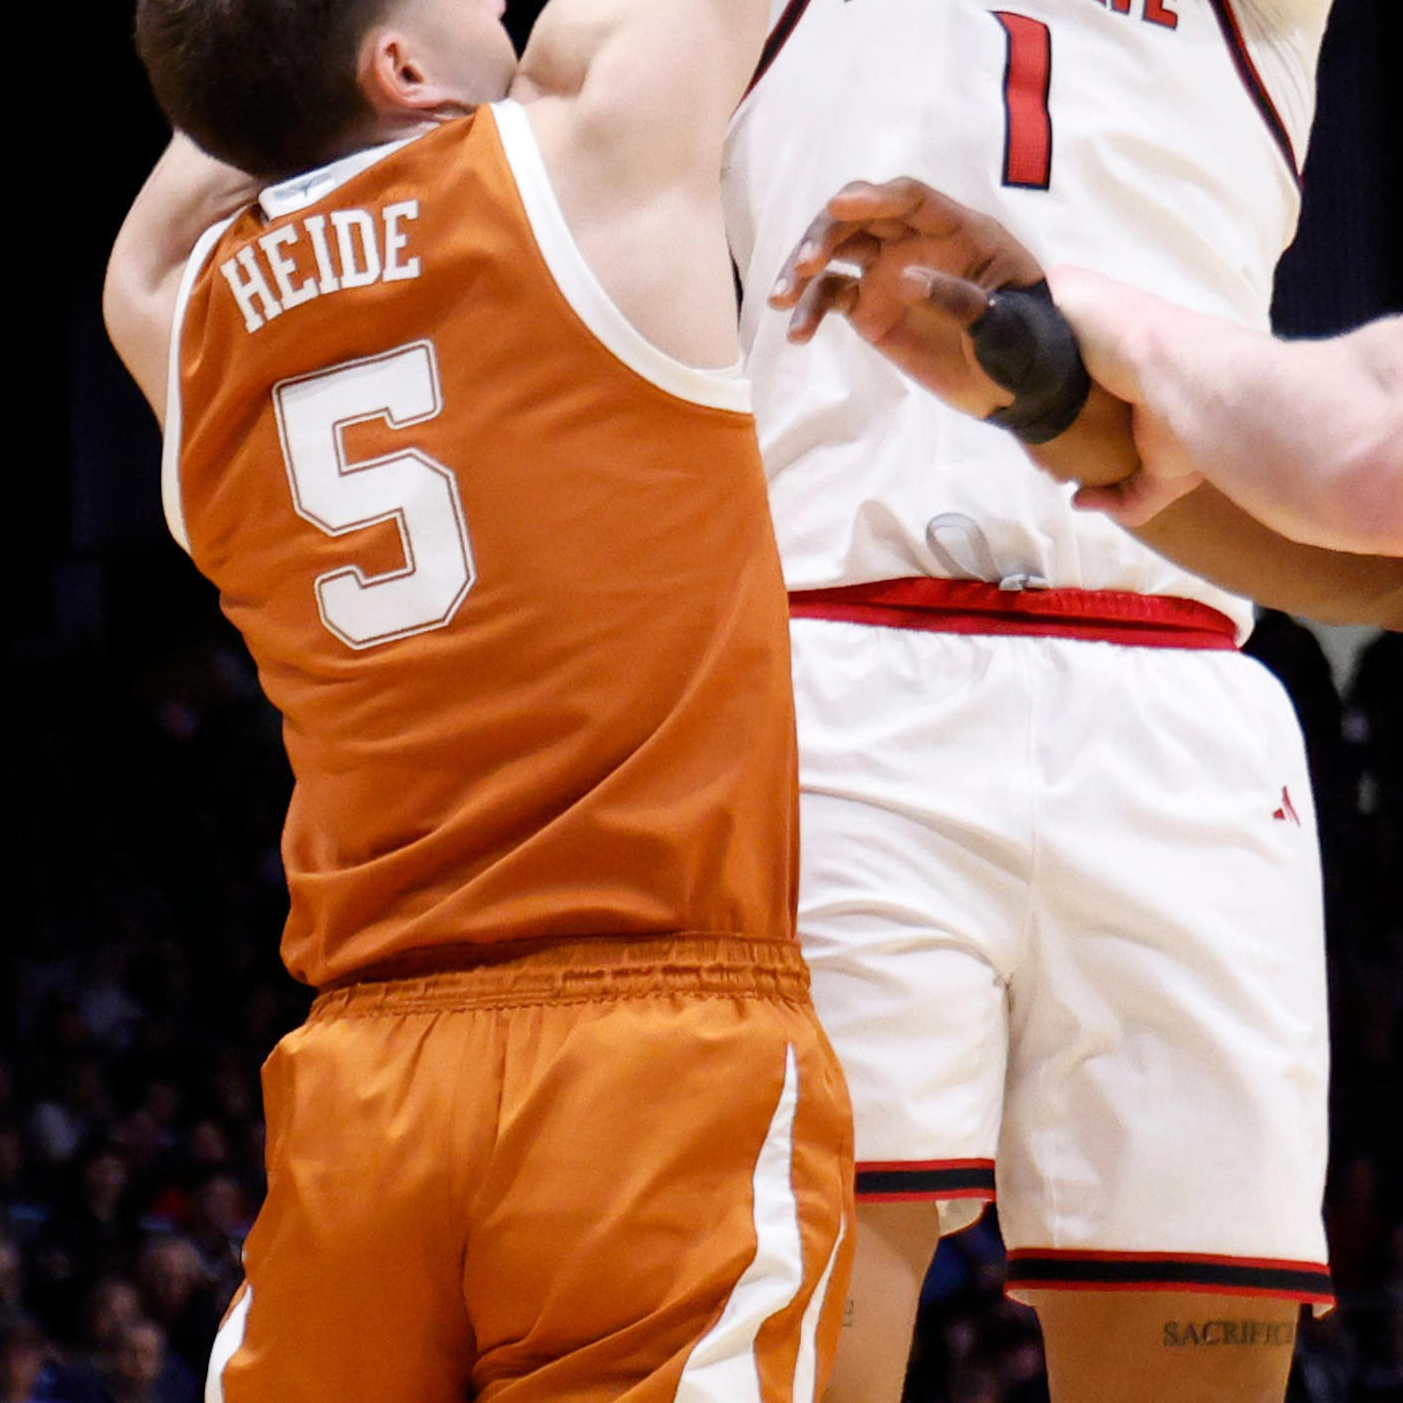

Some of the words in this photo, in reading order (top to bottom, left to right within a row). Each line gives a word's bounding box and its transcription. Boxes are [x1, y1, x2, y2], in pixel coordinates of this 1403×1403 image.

[987, 10, 1053, 191] 1
[220, 198, 421, 334] HEIDE
[272, 339, 477, 650] 5
